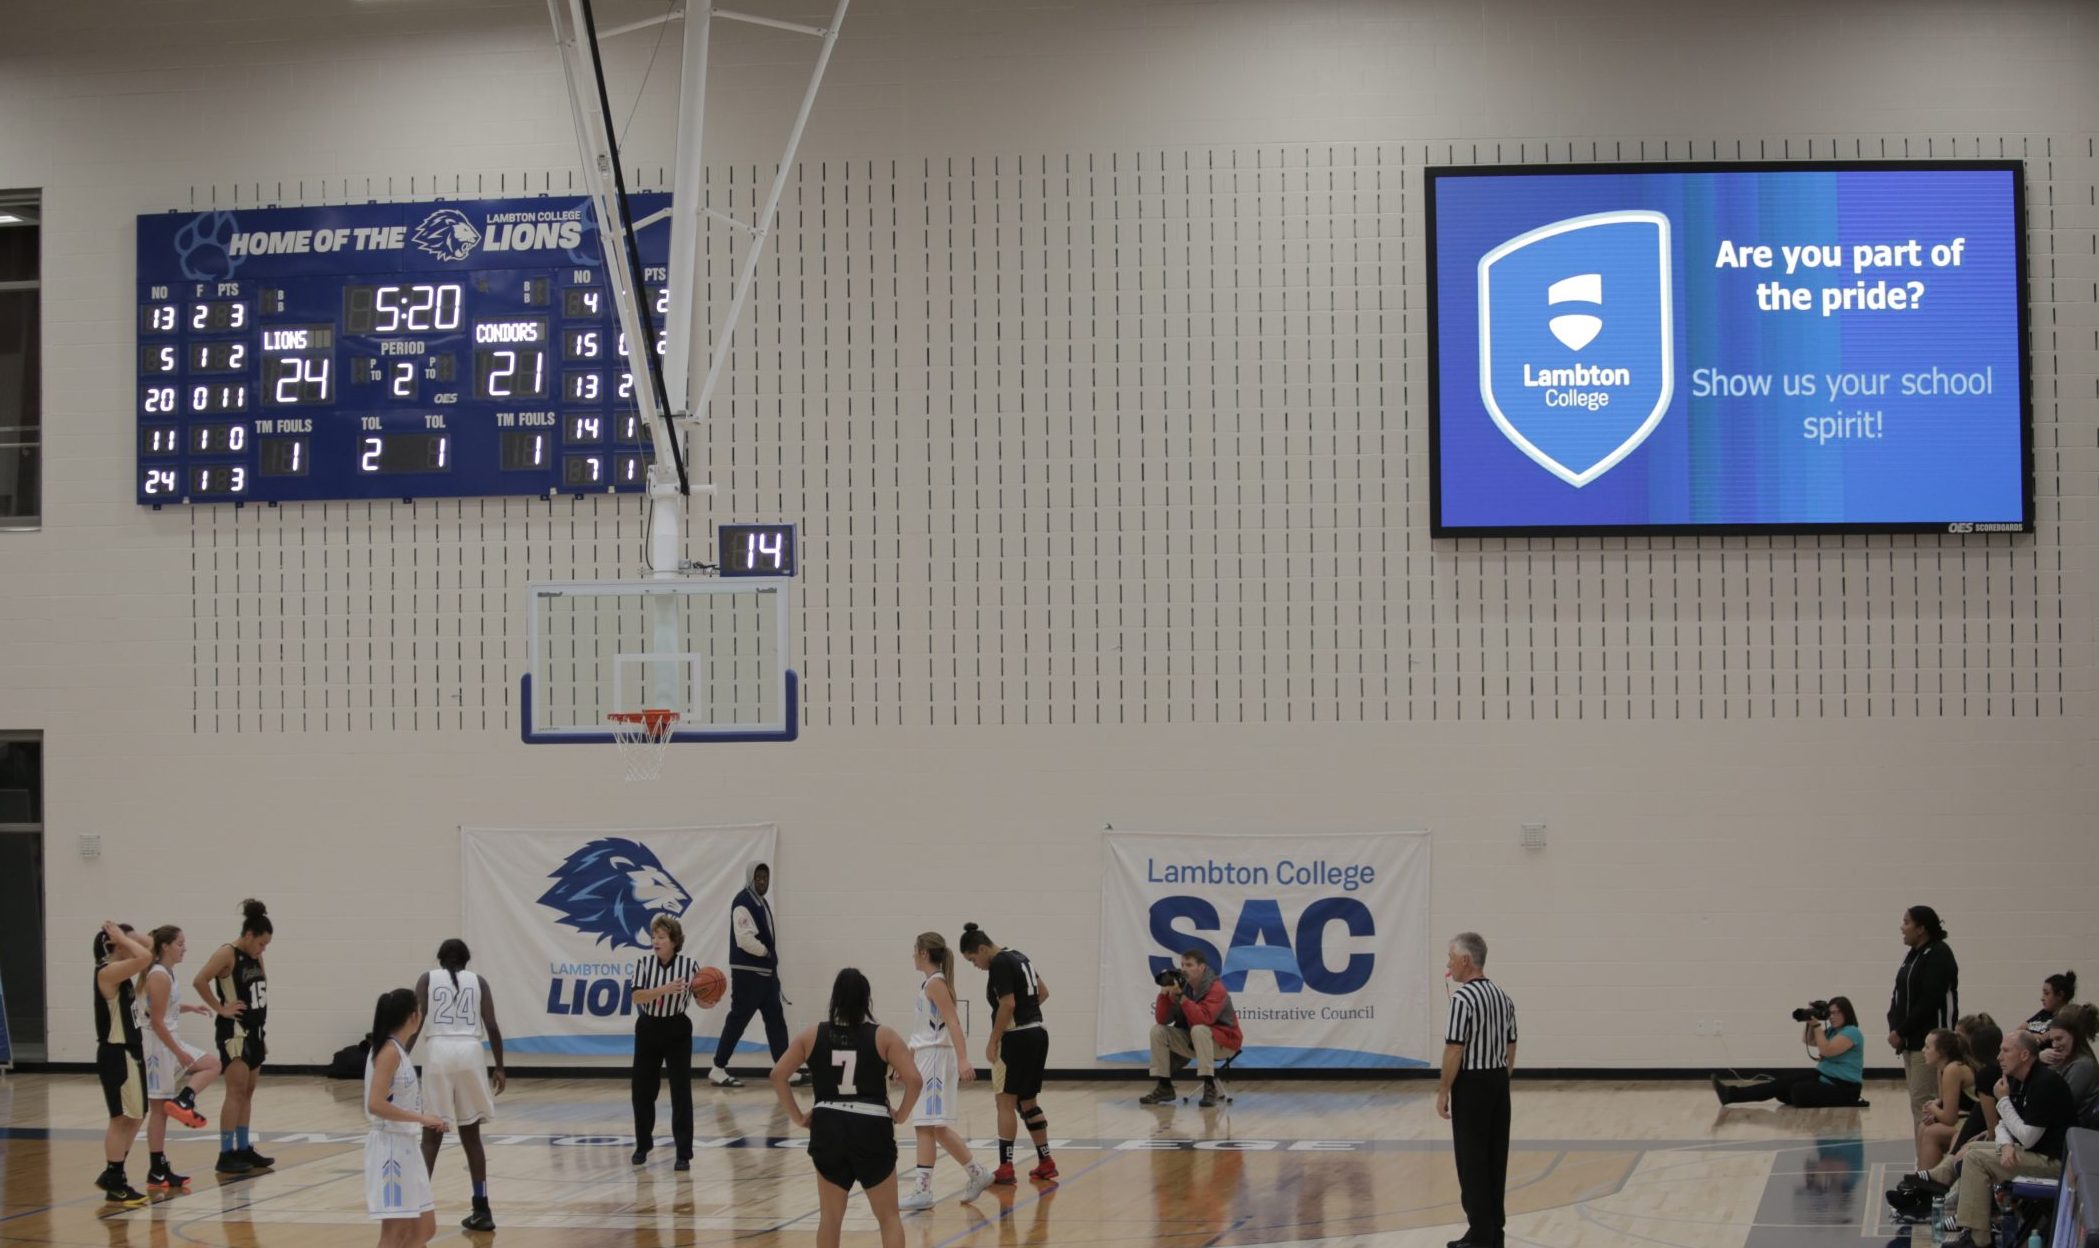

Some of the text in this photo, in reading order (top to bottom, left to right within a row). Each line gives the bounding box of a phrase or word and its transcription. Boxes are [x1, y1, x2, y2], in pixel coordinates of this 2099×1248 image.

[487, 211, 580, 223] LAMBTON COLLEGE
[229, 226, 407, 256] HOME OF THE
[483, 221, 582, 251] LIONS
[1716, 238, 1965, 274] Are you part of
[524, 281, 530, 291] B
[574, 268, 666, 283] NO PTS
[152, 283, 238, 299] NO F PTS
[278, 290, 284, 300] B
[524, 293, 530, 303] B
[584, 289, 669, 313] 4 2
[1756, 281, 1924, 316] the pride?
[154, 304, 244, 330] 13 2 3
[278, 302, 285, 312] B
[376, 285, 461, 331] 5:20
[264, 330, 307, 350] LIONS
[476, 323, 538, 343] CONDORS
[576, 333, 597, 356] 15
[161, 345, 244, 370] 5 1 2
[381, 341, 425, 355] PERIOD
[370, 359, 377, 368] P
[429, 357, 436, 367] P
[489, 351, 542, 396] 21
[276, 358, 328, 402] 24
[370, 370, 381, 380] TO
[394, 363, 413, 395] 2
[425, 369, 436, 379] TO
[1524, 363, 1629, 386] Lambton
[1693, 366, 1992, 402] Show us your school
[577, 374, 633, 398] 13 2
[145, 387, 244, 412] 20 0 11
[434, 393, 458, 403] OES
[1546, 389, 1608, 410] College
[255, 419, 312, 433] TM FOULS
[361, 417, 382, 430] TOL
[425, 415, 446, 428] TOL
[496, 412, 555, 426] TM FOULS
[577, 417, 634, 439] 14 1
[1804, 411, 1883, 444] spirit!
[154, 427, 244, 450] 11 1 0
[535, 436, 541, 464] 1
[292, 443, 299, 471] 1
[362, 438, 382, 471] 2
[439, 438, 445, 467] 1
[145, 468, 244, 493] 24 1 3
[587, 459, 634, 480] 7 1
[1948, 523, 2023, 533] OES SCOREBOARDS
[748, 533, 781, 568] 14
[1148, 858, 1375, 891] Lambton College
[1149, 895, 1375, 995] SAC
[550, 963, 620, 976] LAMBTON
[249, 981, 266, 1010] 15
[433, 986, 475, 1026] 24
[547, 978, 633, 1017] LIO
[1321, 1006, 1374, 1020] Council
[831, 1050, 857, 1095] 7
